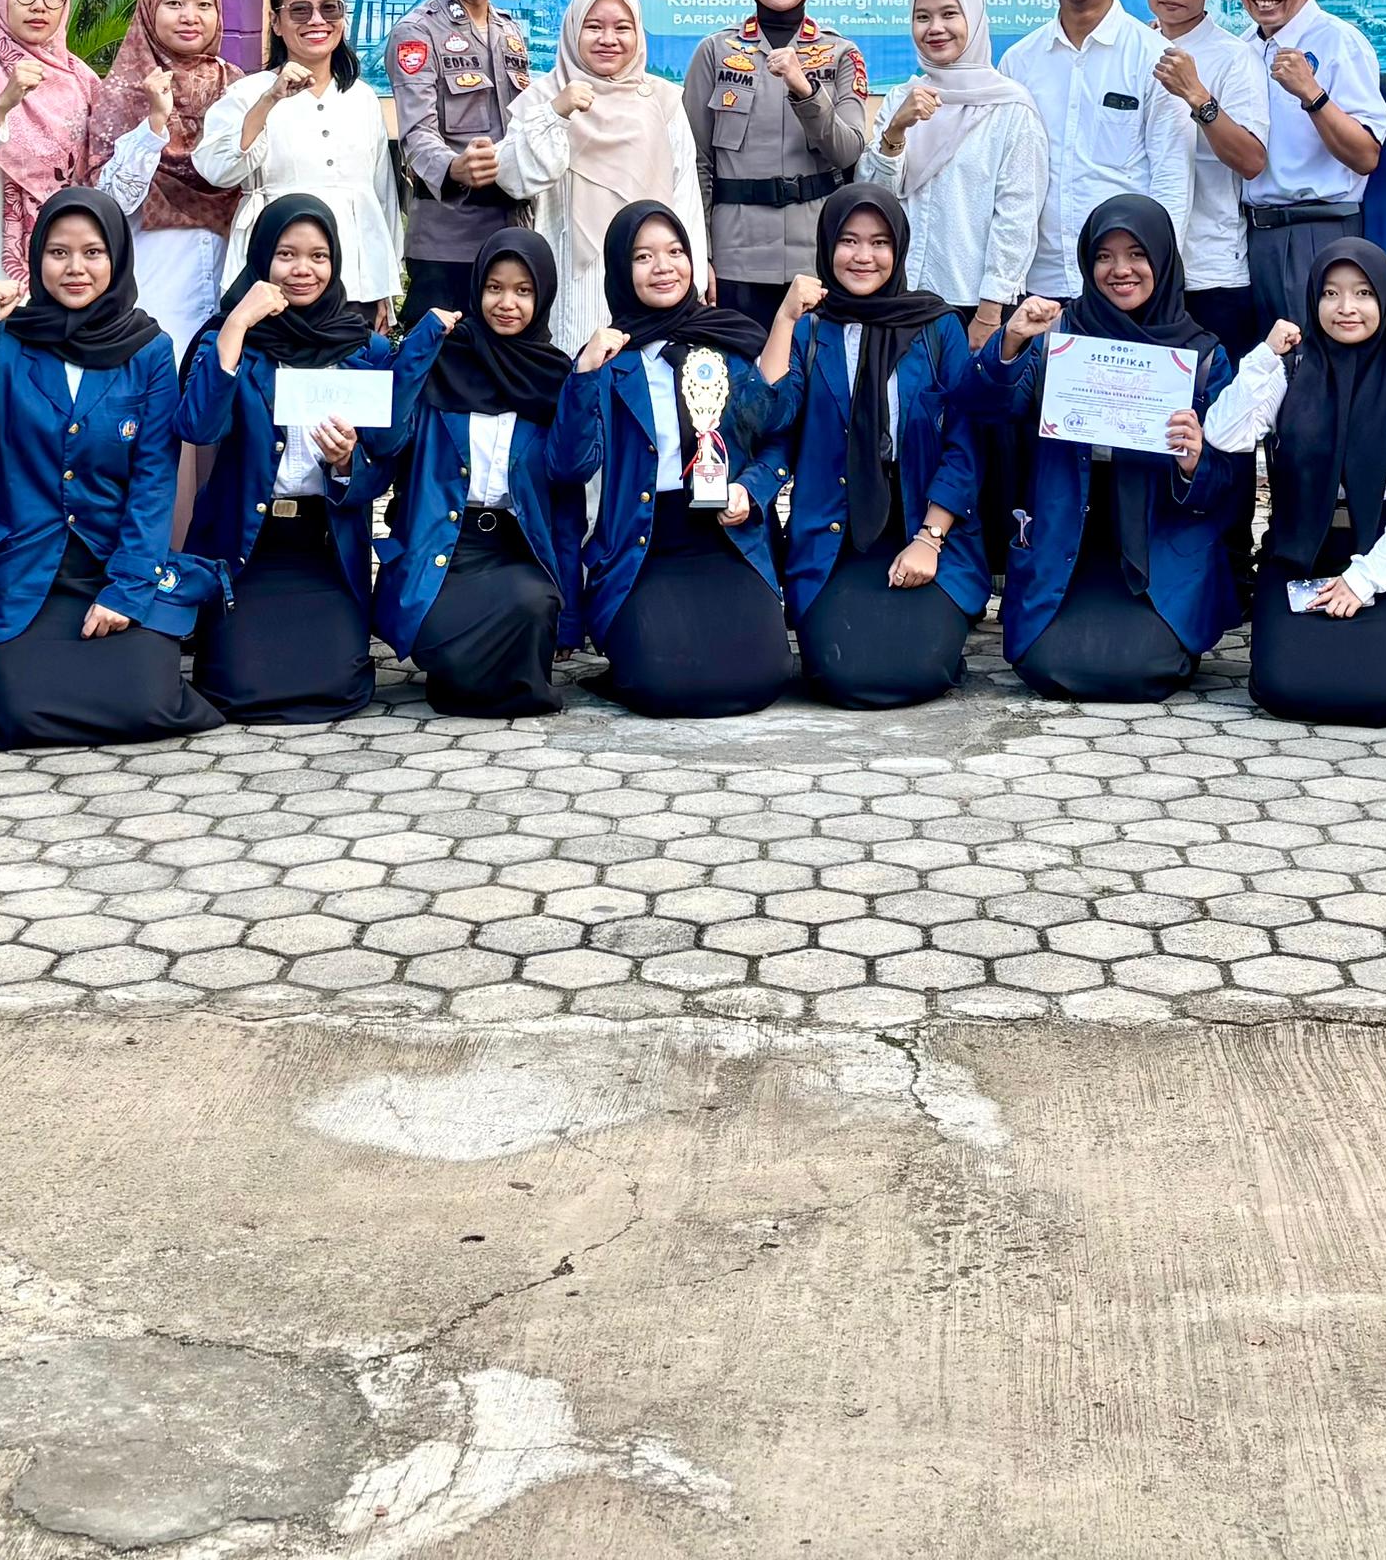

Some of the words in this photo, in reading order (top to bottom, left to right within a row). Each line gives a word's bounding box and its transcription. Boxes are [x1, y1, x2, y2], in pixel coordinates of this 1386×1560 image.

[673, 14, 737, 24] BARISAN
[891, 15, 911, 24] Ind
[717, 69, 754, 86] ARUM
[1091, 353, 1153, 369] SERTIFIKAT
